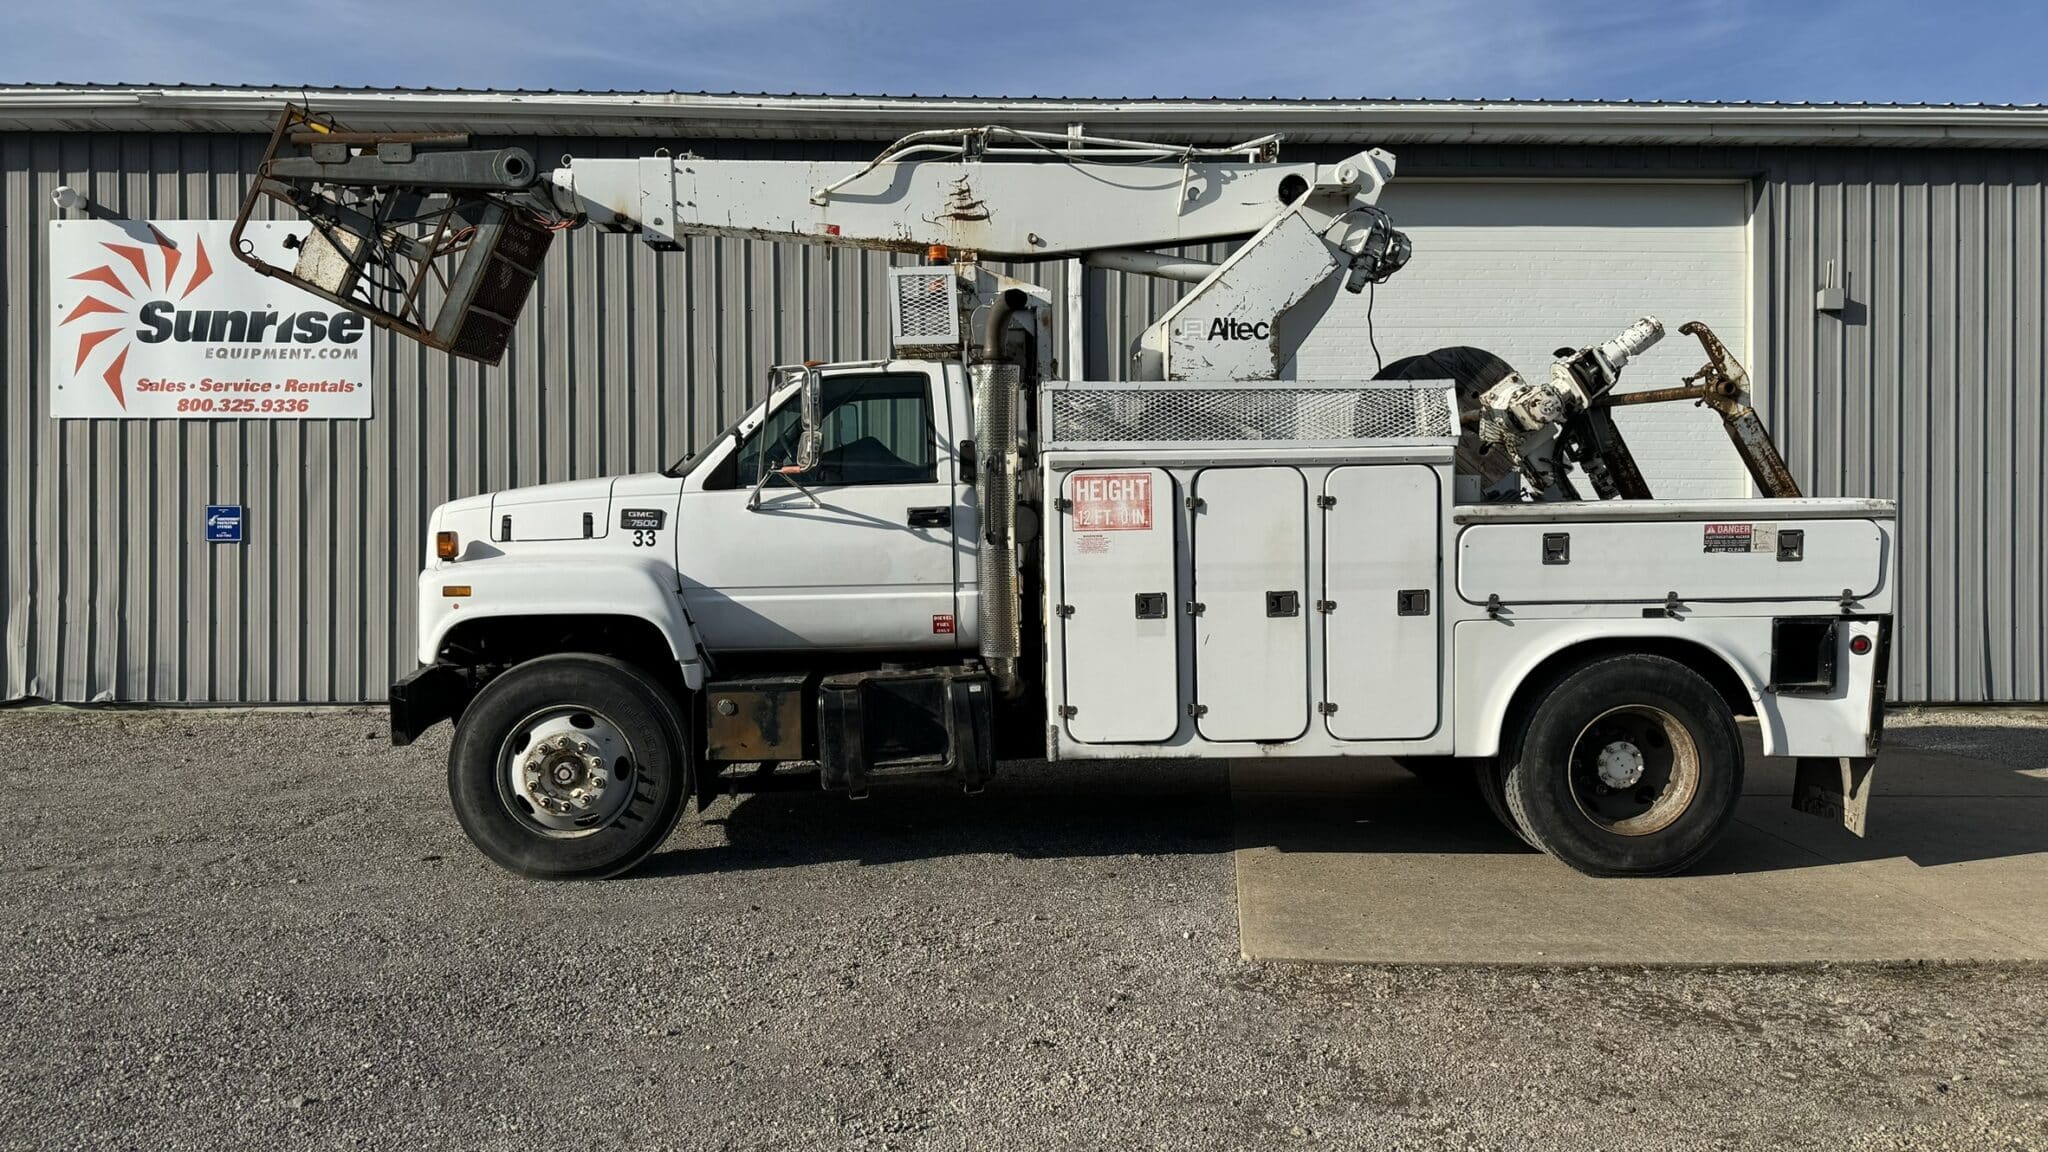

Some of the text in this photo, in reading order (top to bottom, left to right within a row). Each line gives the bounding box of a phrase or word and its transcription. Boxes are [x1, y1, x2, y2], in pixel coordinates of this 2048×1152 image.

[136, 300, 365, 344] Sunrise
[1207, 317, 1269, 341] Altec
[205, 348, 359, 360] EQUIPMENT.COM
[136, 378, 354, 393] Sales Service Rentals
[177, 398, 309, 413] 800.325.9336
[1076, 479, 1148, 502] HEIGHT
[1078, 509, 1091, 526] 12
[1094, 509, 1114, 526] FT.
[1132, 508, 1149, 525] IN.
[1717, 525, 1750, 533] DANGER
[632, 530, 656, 547] 33
